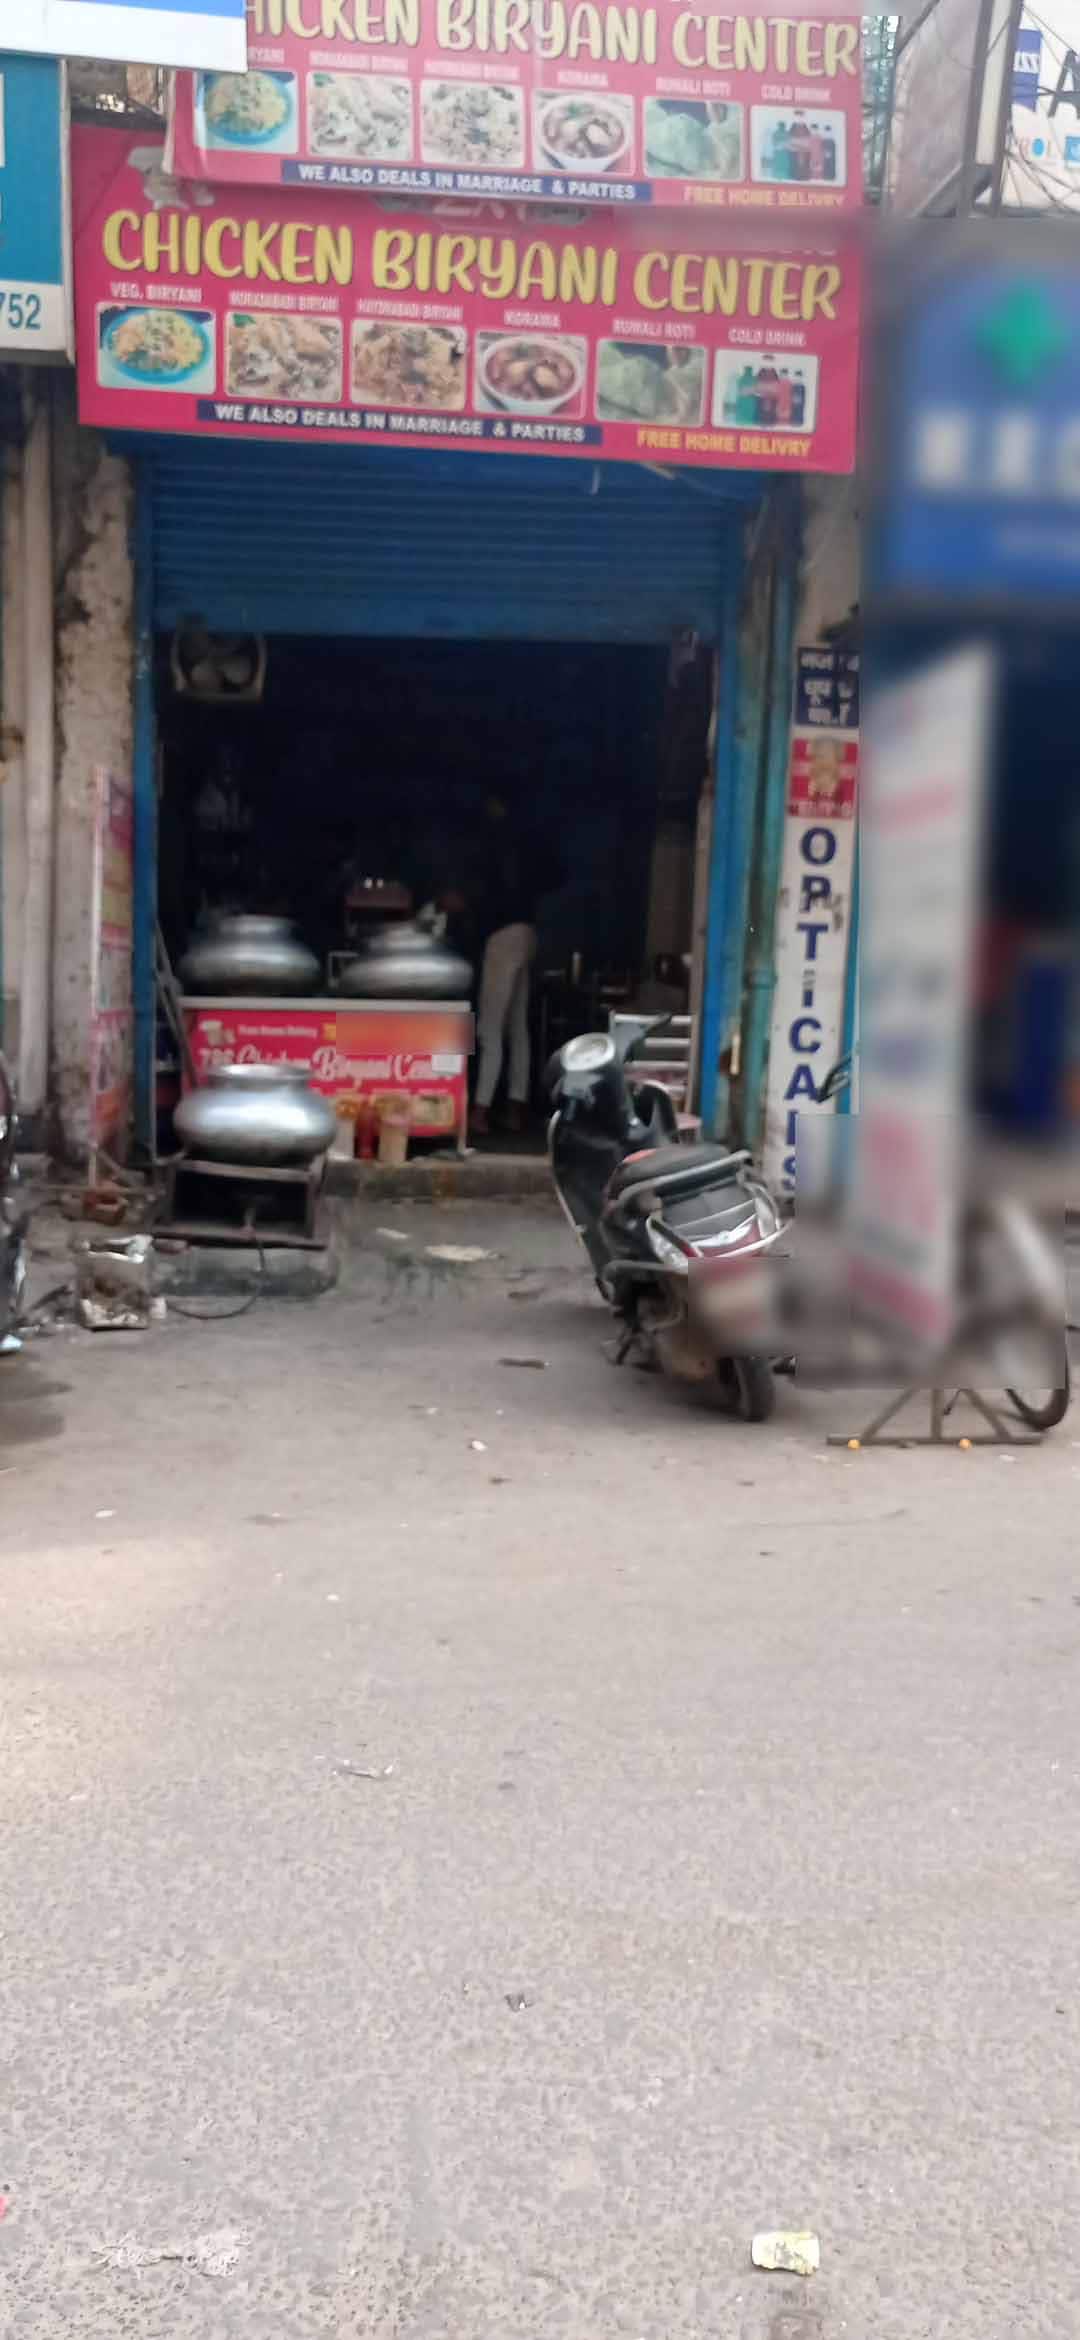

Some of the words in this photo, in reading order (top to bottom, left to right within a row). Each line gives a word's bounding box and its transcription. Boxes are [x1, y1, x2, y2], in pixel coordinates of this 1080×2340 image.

[247, 0, 420, 47] ICKEN
[436, 0, 656, 65] BIRYANI
[672, 11, 859, 78] CENTER
[761, 84, 793, 100] COLD
[298, 164, 325, 180] WE
[328, 166, 375, 183] ALSO
[377, 170, 431, 186] DEALS
[435, 173, 454, 188] IN
[457, 174, 543, 193] MARRIAGE
[552, 180, 564, 195] &
[567, 182, 637, 199] PARTIES
[684, 186, 724, 204] FREE
[727, 189, 776, 207] HOME
[103, 209, 353, 286] CHICKEN
[372, 229, 619, 306] BIRYANI
[634, 251, 841, 321] CENTER
[110, 281, 144, 299] VEG.
[146, 285, 202, 303] BIRYANI
[0, 293, 42, 331] 52
[612, 318, 662, 336] RUMALI
[664, 322, 696, 341] ROTI
[728, 327, 762, 345] COLD
[765, 330, 807, 346] DRINK
[214, 404, 244, 421] WE
[250, 407, 299, 424] ALSO
[302, 410, 361, 427] DEALS
[365, 413, 386, 430] IN
[389, 415, 484, 435] MARRIAGE
[492, 422, 506, 438] &
[511, 425, 586, 442] PARTIES
[637, 428, 681, 449] FREE
[685, 433, 736, 452] HOME
[739, 436, 812, 456] DELIVRY
